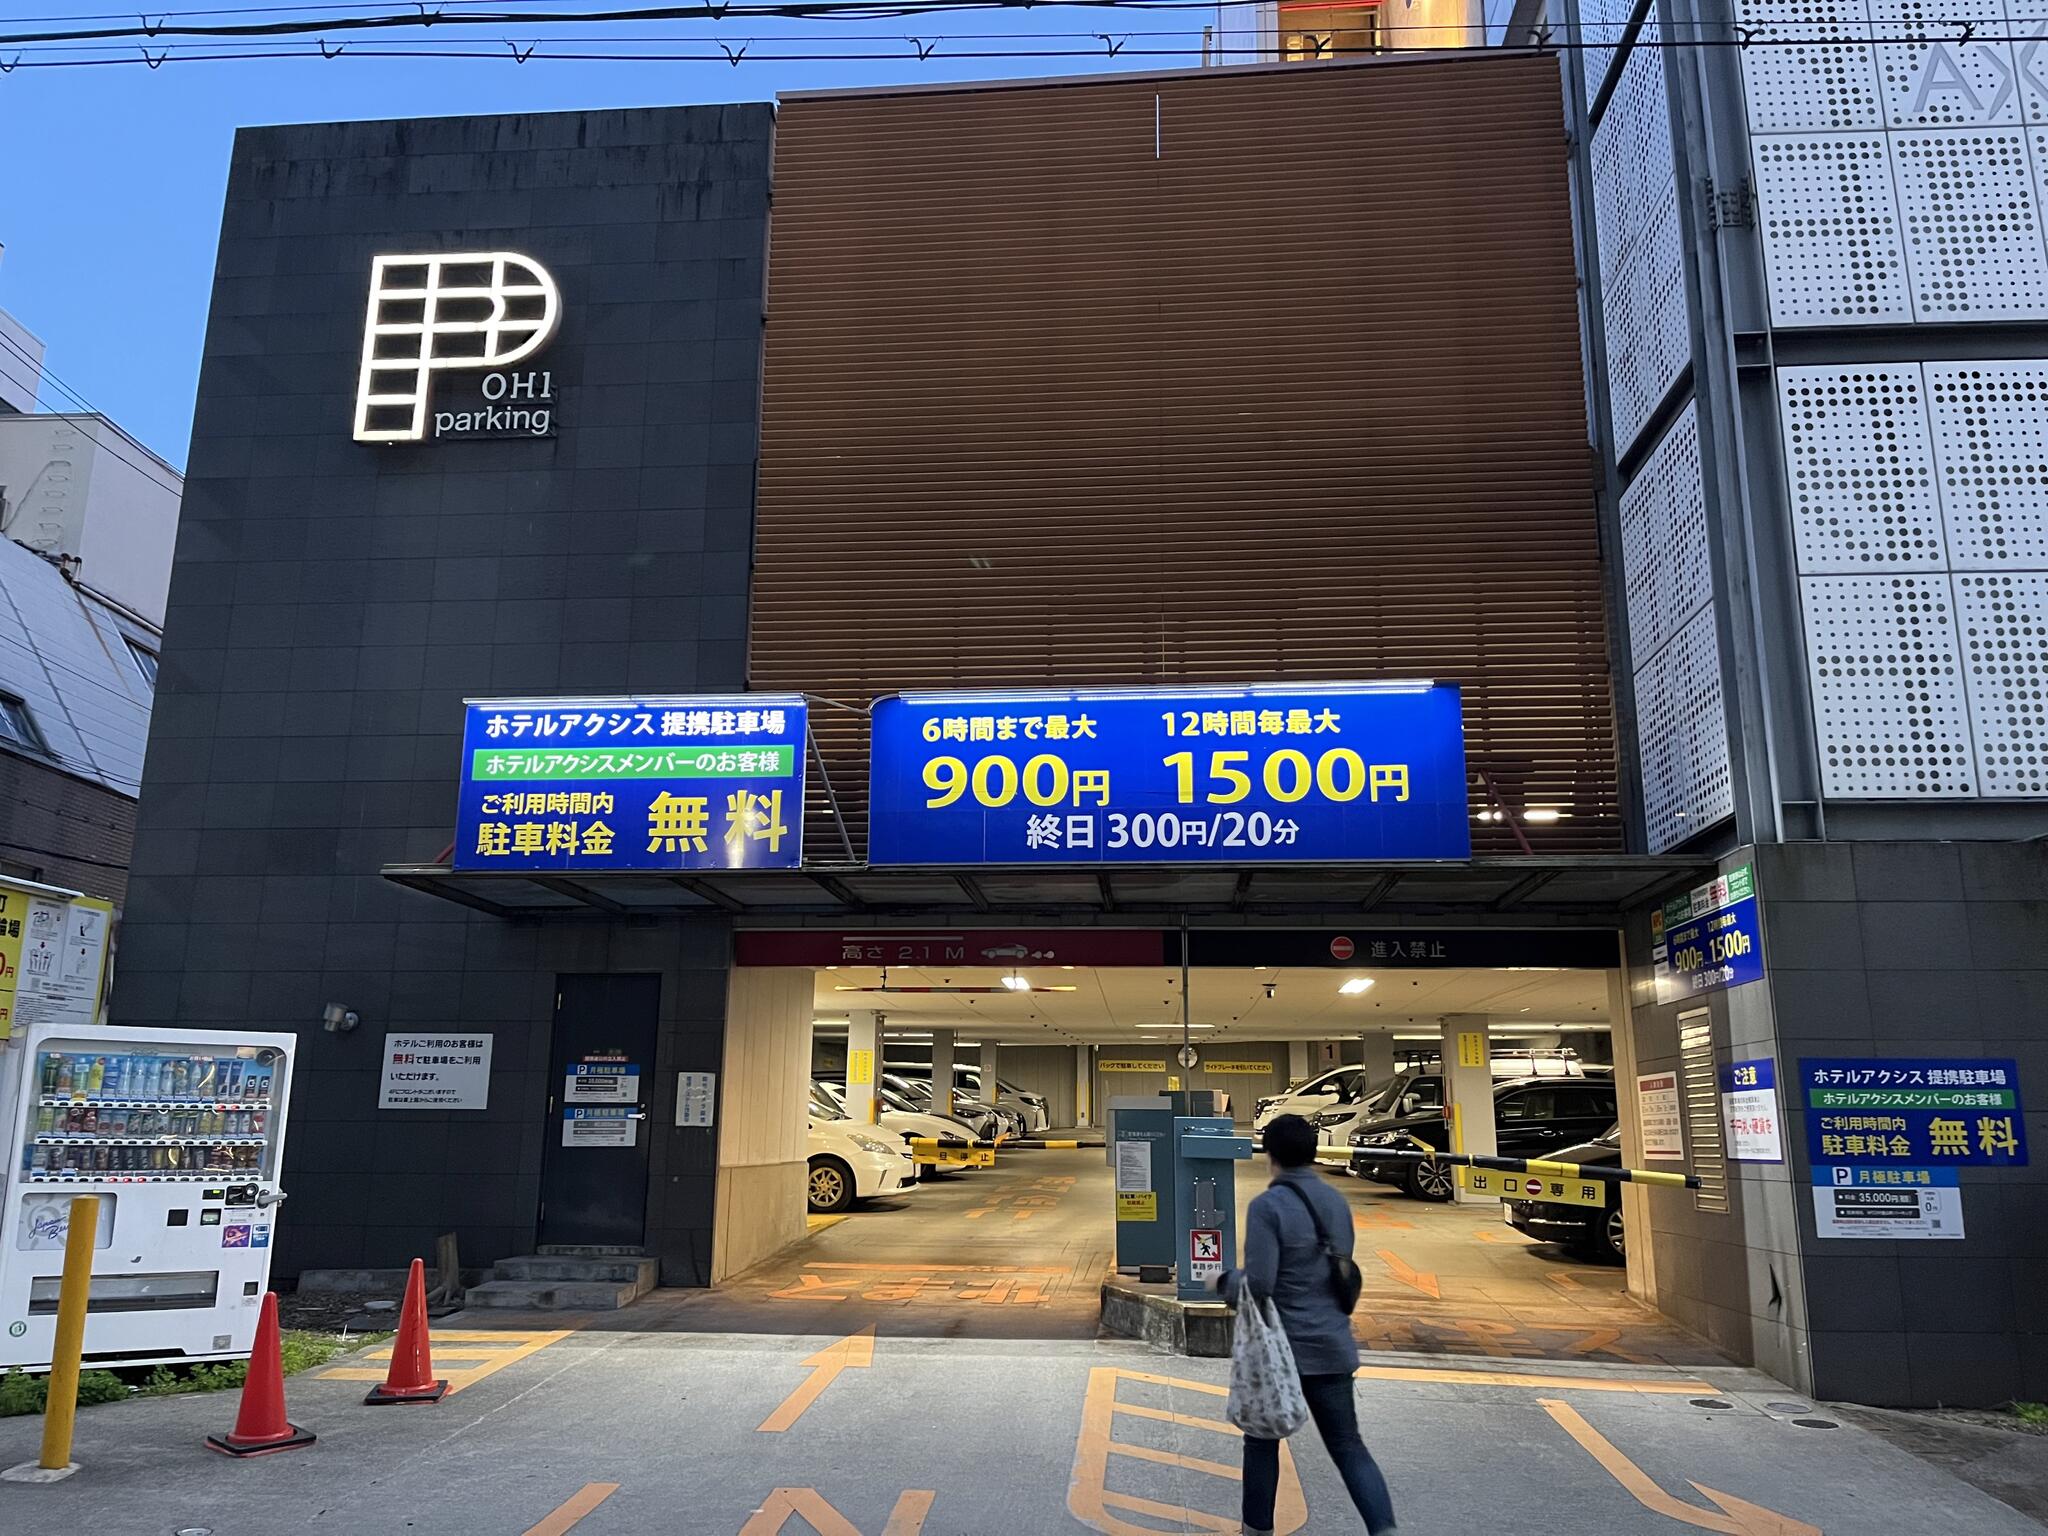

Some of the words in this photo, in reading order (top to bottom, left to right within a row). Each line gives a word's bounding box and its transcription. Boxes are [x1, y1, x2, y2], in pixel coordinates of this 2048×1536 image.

[435, 405, 550, 437] parking
[485, 713, 655, 738] ホテルアクシス
[660, 710, 786, 737] 提携駐車場
[922, 713, 1097, 742] 6時間まで最大
[1161, 709, 1341, 737] 12時間毎最大
[485, 751, 781, 775] ホテルアクシスメンバーのお客様
[921, 753, 1110, 809] 900円
[1162, 747, 1410, 805] 1500円
[481, 792, 615, 816] ご利用時間内
[646, 789, 789, 854] 無料
[1026, 813, 1095, 850] 終日
[1106, 810, 1300, 850] 300円/20分
[475, 820, 616, 856] 駐車料金
[842, 945, 883, 960] 高さ
[898, 946, 930, 959] 2.1
[945, 946, 965, 959] M
[1370, 940, 1446, 959] 進入禁止
[1709, 929, 1751, 963] 1500円
[1674, 946, 1704, 974] 900円
[393, 1040, 483, 1048] ホテルご利用のお客様は
[1327, 1044, 1333, 1059] 1
[390, 1072, 439, 1081] いただけます。
[1734, 1066, 1757, 1085] ご注意
[1814, 1069, 1924, 1084] ホテルアクシス
[1927, 1069, 2007, 1085] 提携駐車場
[1823, 1092, 2003, 1106] ホテルアクシスメンバーのお客様
[1820, 1117, 1907, 1131] ご利用時間内
[1928, 1116, 2019, 1156] 無料
[1822, 1135, 1911, 1157] 駐車料金
[1836, 1168, 1848, 1183] P
[1858, 1170, 1931, 1184] 月極駐車場
